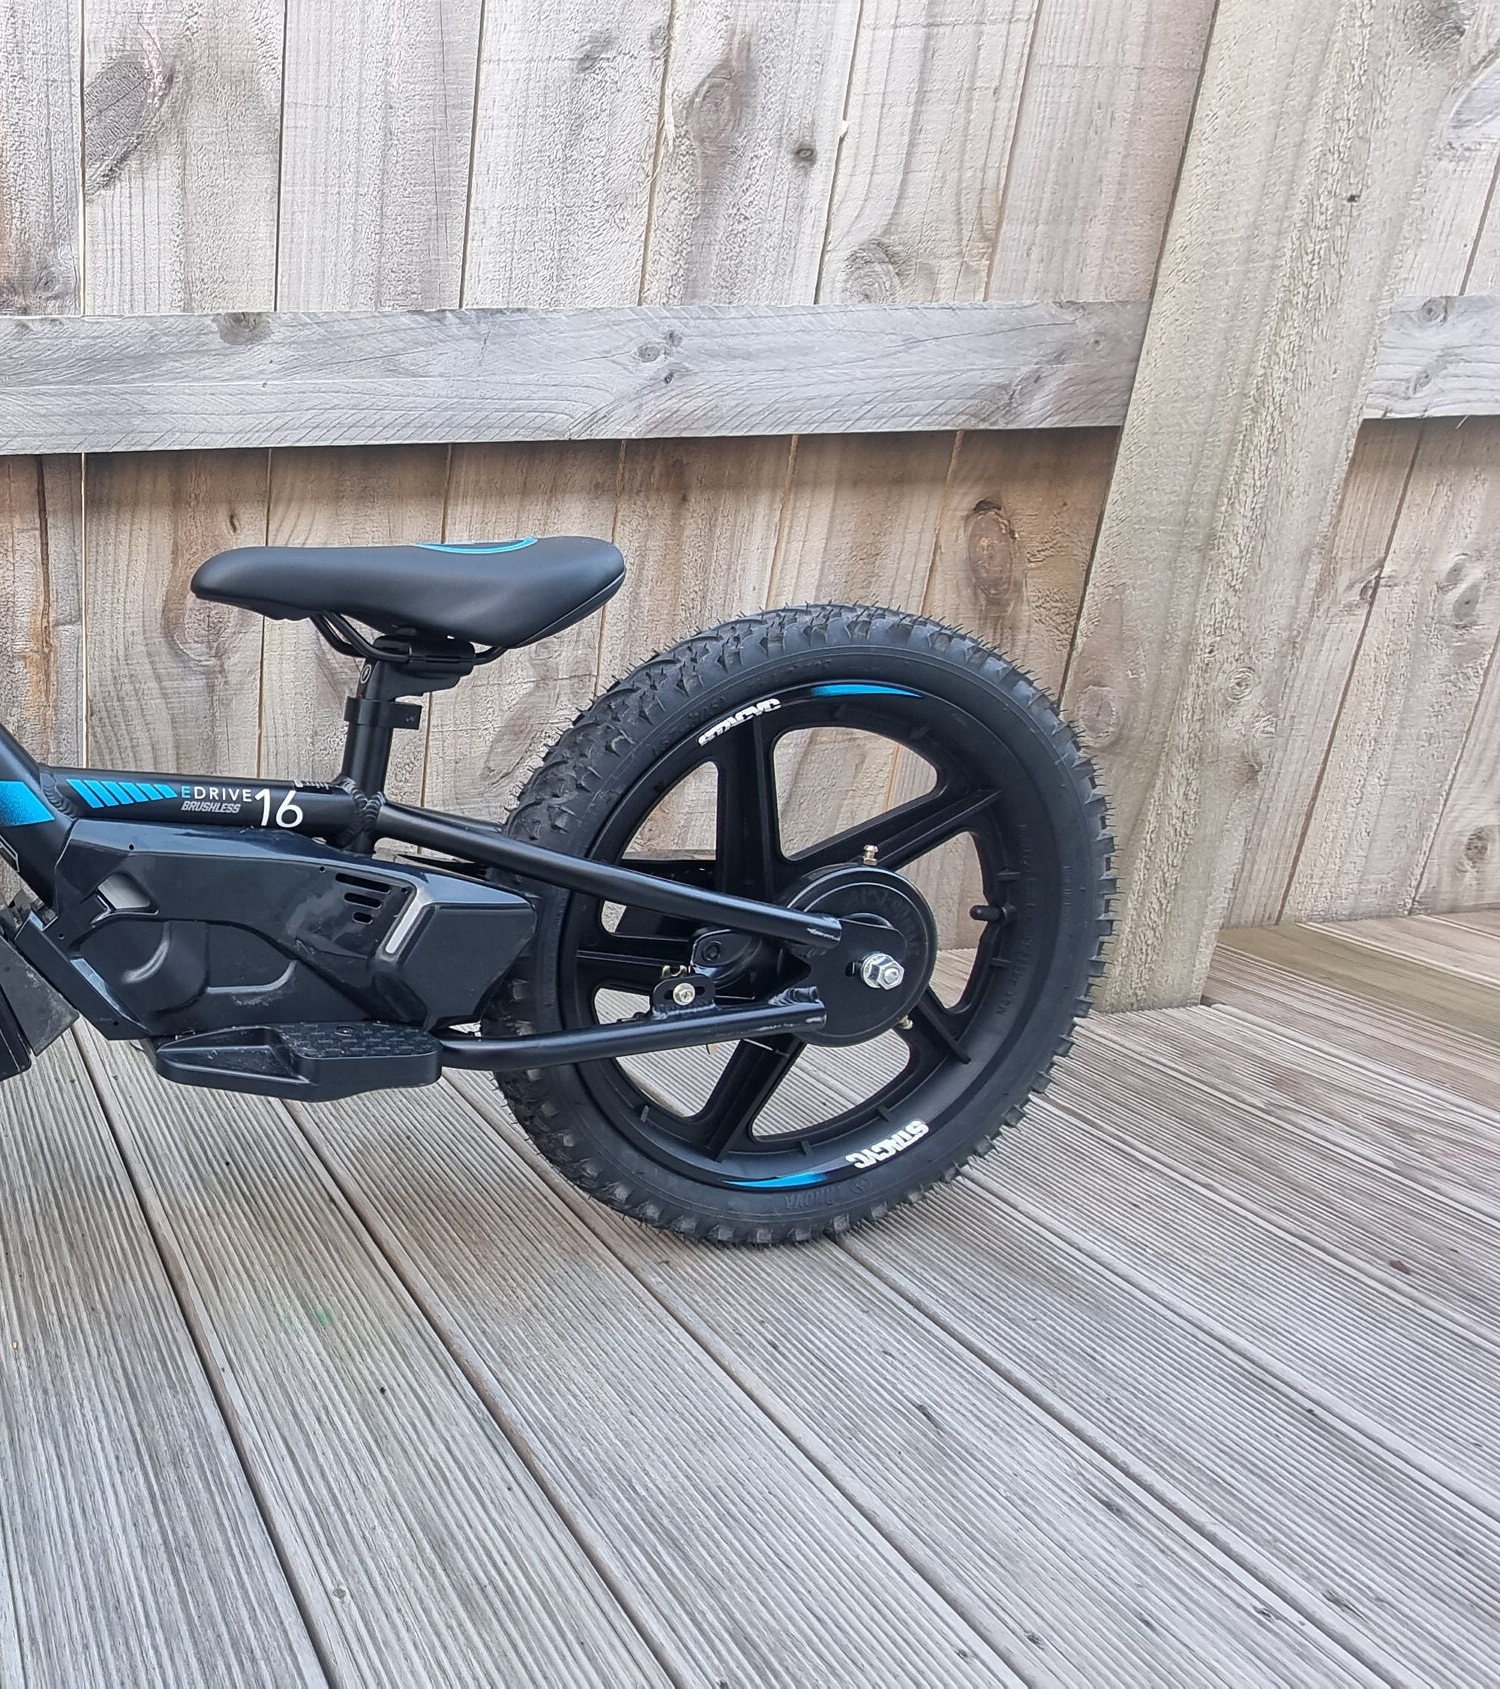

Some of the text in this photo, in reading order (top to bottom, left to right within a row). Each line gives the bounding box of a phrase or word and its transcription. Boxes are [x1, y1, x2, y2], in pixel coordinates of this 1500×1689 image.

[180, 785, 304, 829] EDRIVE 16
[180, 800, 242, 814] BRUSHLESS
[845, 1119, 930, 1169] STACYC
